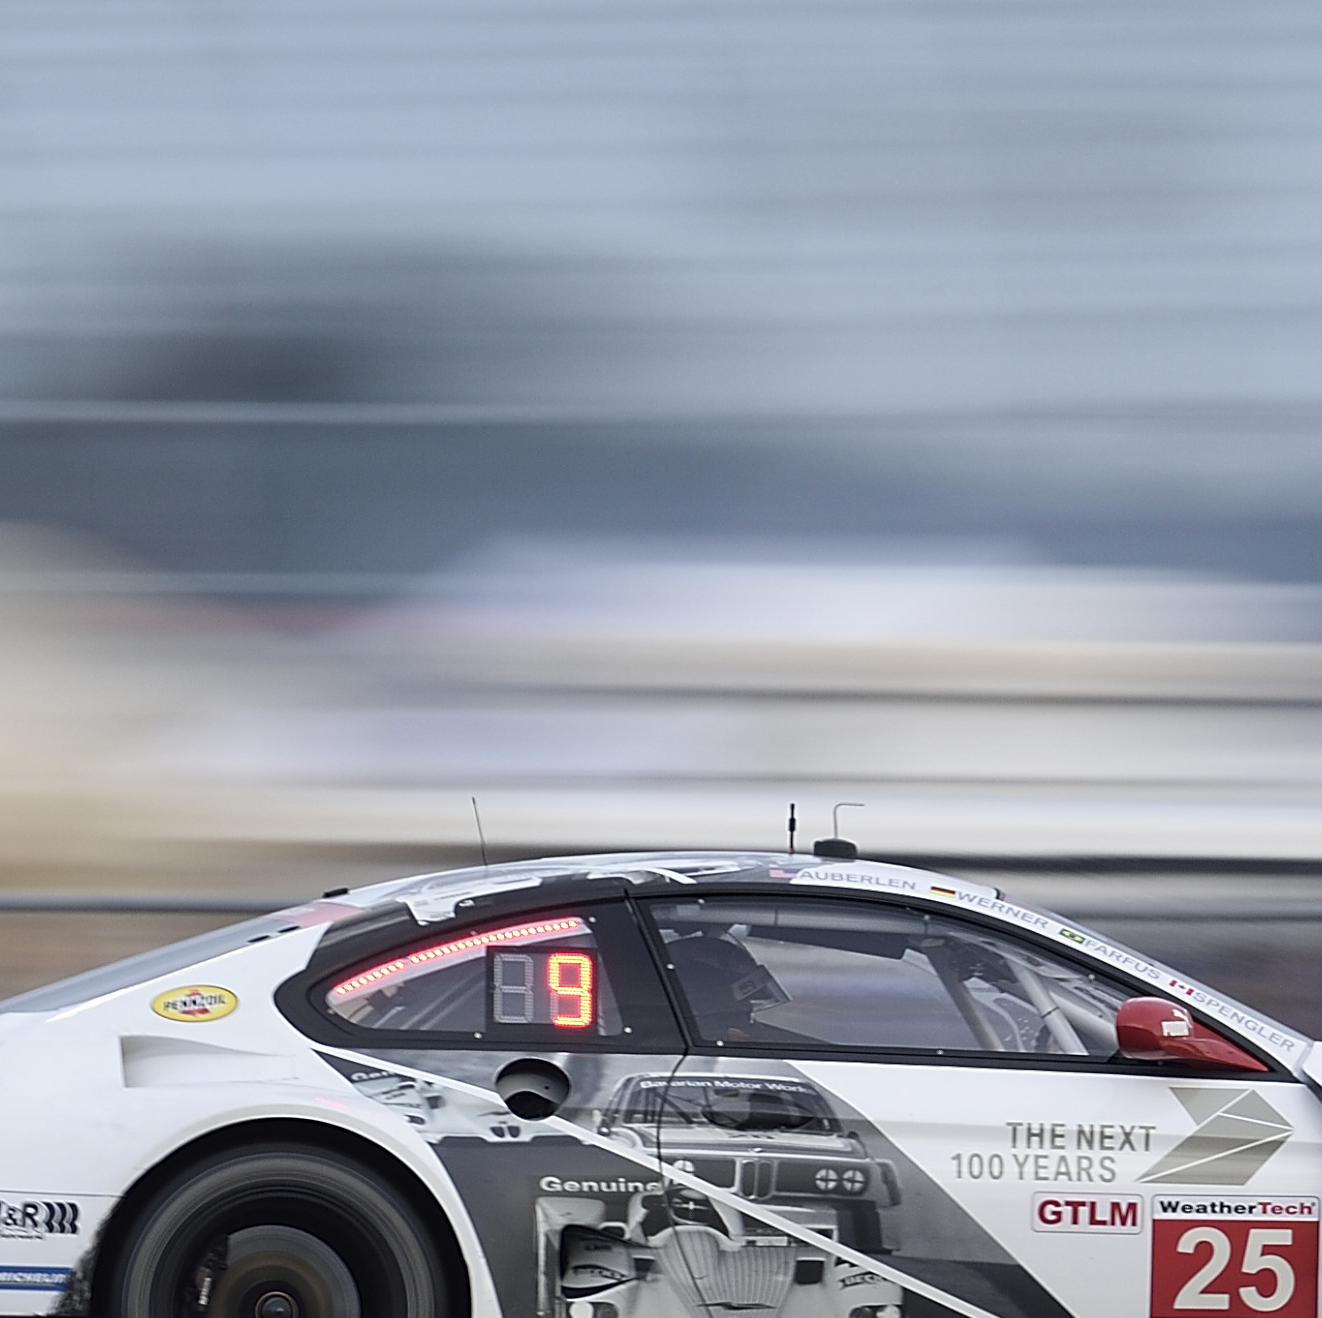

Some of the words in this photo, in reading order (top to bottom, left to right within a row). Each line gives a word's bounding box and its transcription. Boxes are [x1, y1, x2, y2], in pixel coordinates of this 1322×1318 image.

[799, 870, 917, 891] AUBERLEN
[957, 890, 1049, 929] WERNER
[1083, 938, 1162, 980] FARFUS
[1191, 991, 1296, 1051] SPENGLER
[1006, 1121, 1067, 1149] THE
[1076, 1123, 1157, 1152] NEXT
[951, 1152, 1004, 1180] 100
[1012, 1153, 1117, 1183] YEARS
[539, 1175, 661, 1192] Genuine
[1037, 1199, 1138, 1227] GTLM
[1160, 1200, 1313, 1216] WeatherTech
[1173, 1226, 1296, 1312] 25
